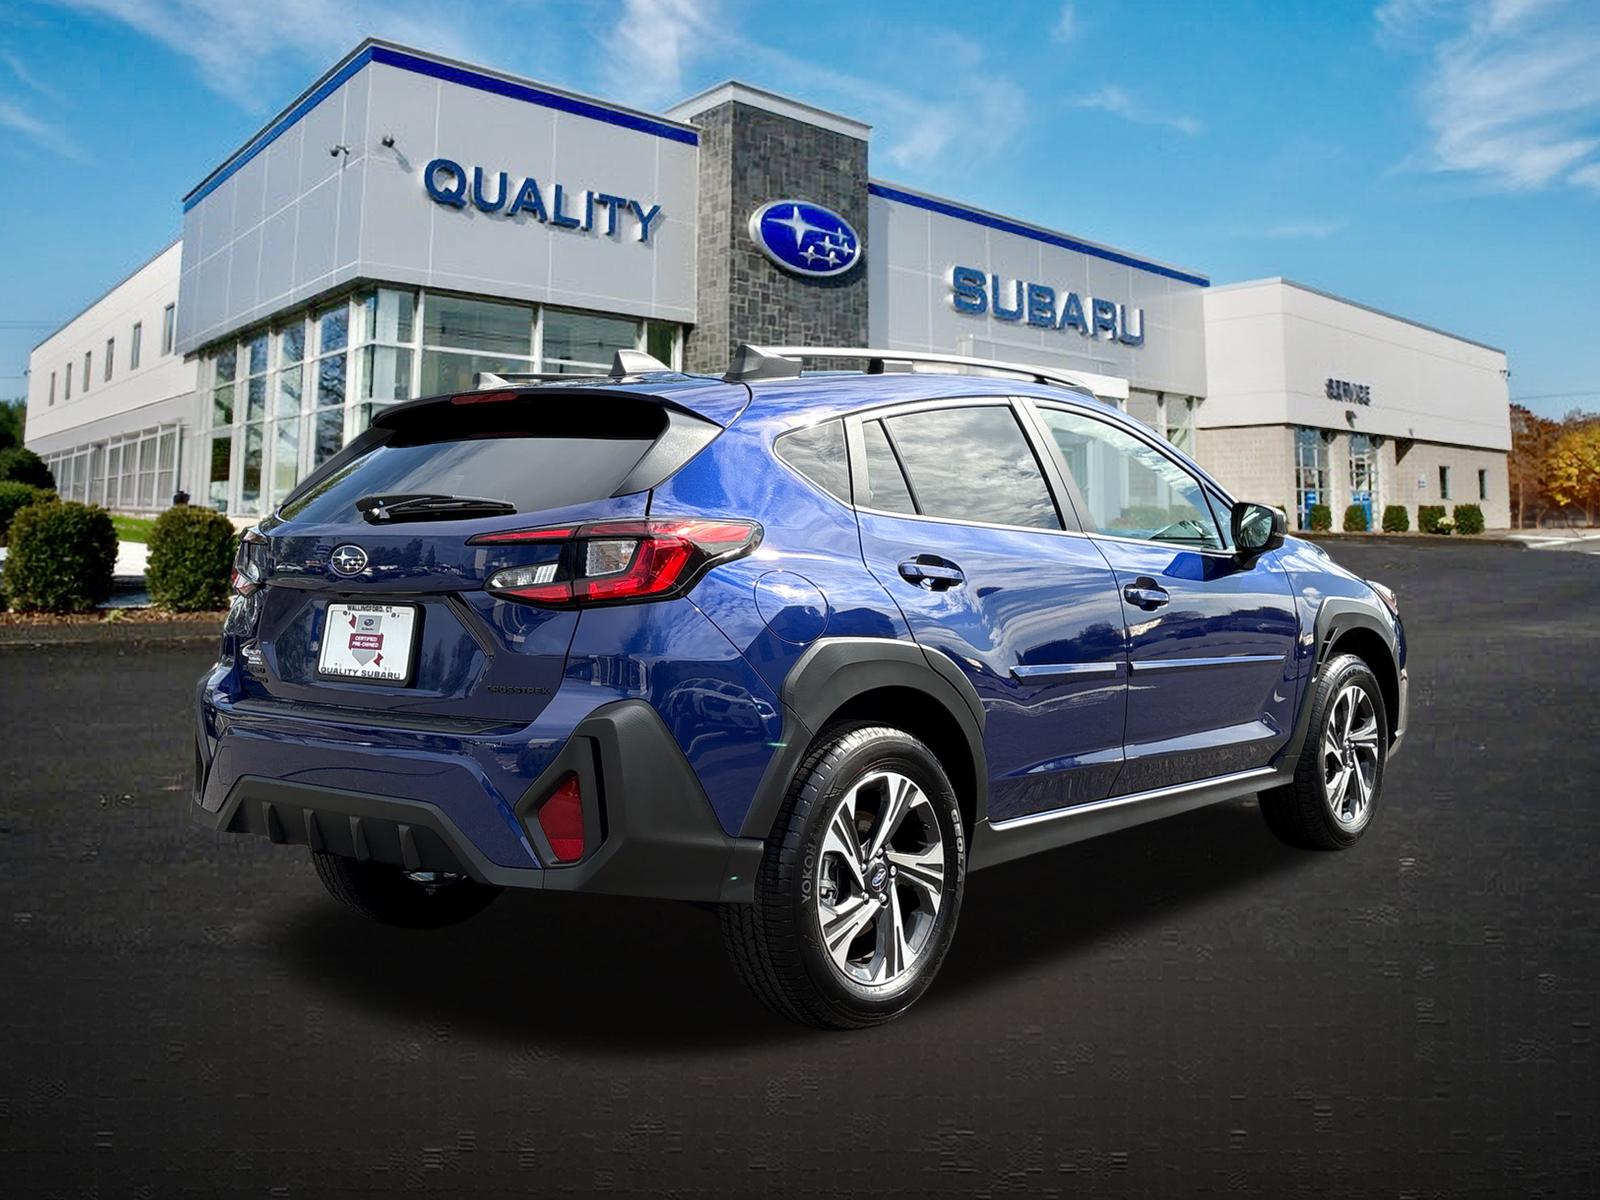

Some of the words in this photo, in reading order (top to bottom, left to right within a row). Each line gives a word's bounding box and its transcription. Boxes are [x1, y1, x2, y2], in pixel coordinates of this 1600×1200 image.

[424, 158, 662, 243] QUALITY
[952, 265, 1145, 347] SUBARU
[1324, 377, 1371, 407] SERVICE
[320, 666, 359, 676] QUALITY
[361, 670, 401, 680] SUBARU
[487, 685, 551, 695] CROSSTREK
